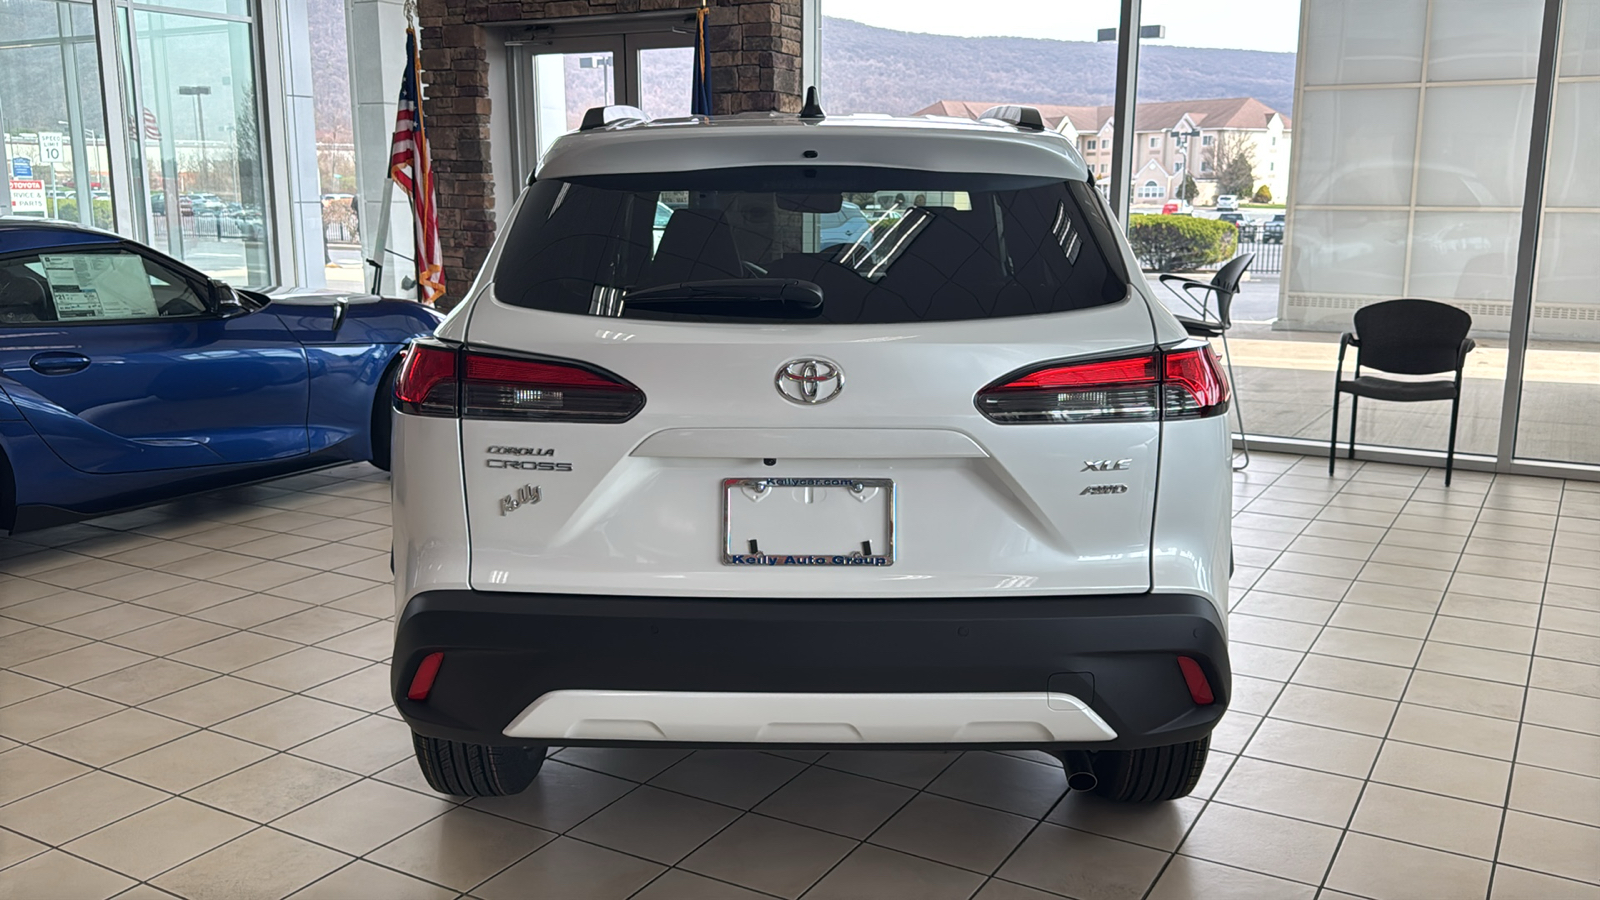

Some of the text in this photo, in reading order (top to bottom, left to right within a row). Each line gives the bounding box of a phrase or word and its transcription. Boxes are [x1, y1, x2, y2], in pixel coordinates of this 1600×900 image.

[45, 148, 59, 159] 10
[486, 445, 555, 457] COROLLA
[486, 459, 573, 471] CROSS
[1080, 458, 1132, 472] XLE
[766, 478, 853, 487] Kellycar.com
[1079, 483, 1128, 495] AWD
[499, 483, 542, 516] Kelly
[732, 555, 886, 566] Kelly Auto Group
